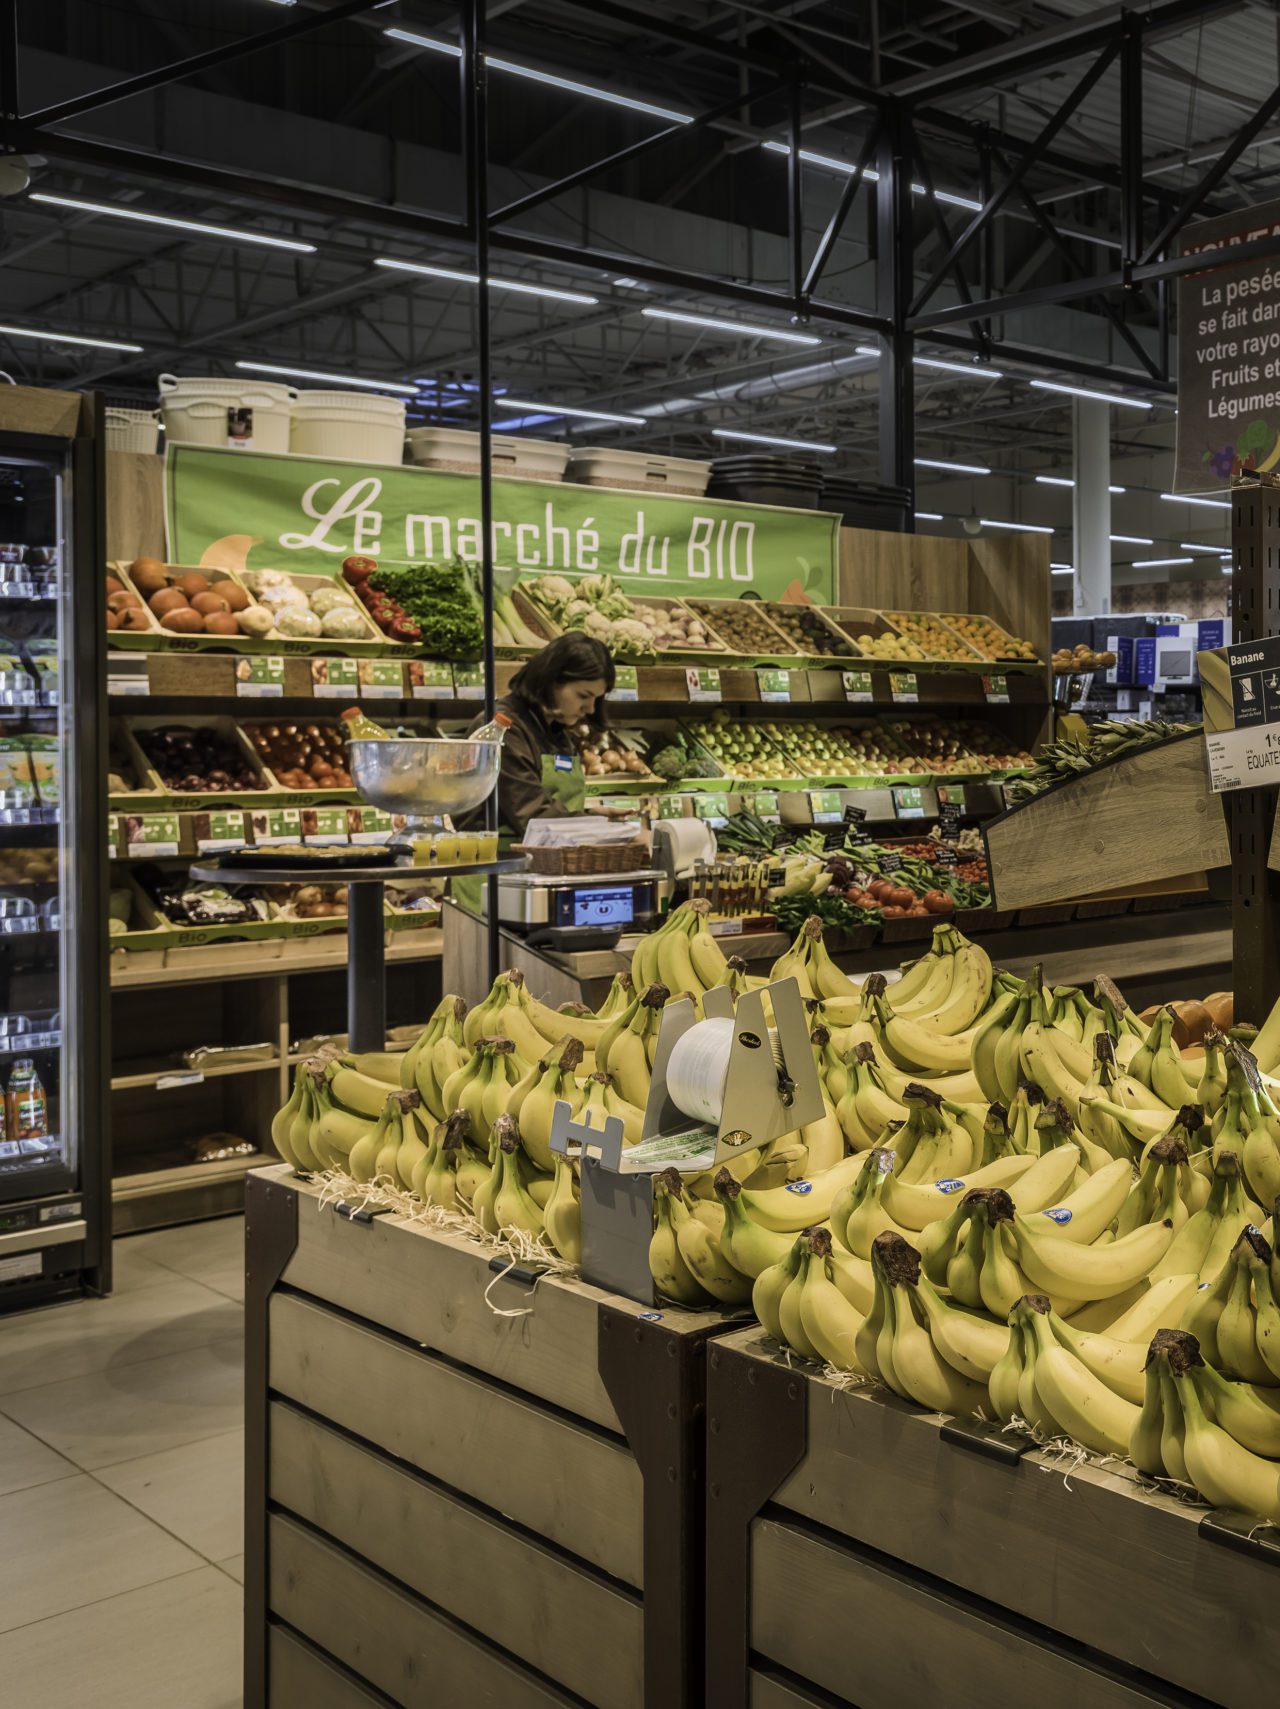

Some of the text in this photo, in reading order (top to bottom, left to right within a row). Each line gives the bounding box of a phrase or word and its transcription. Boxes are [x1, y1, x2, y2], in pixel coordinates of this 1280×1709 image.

[1202, 287, 1222, 306] La
[1198, 317, 1217, 335] se
[1221, 303, 1248, 330] fait
[1196, 339, 1238, 364] votre
[1211, 358, 1280, 389] Fruits et
[279, 477, 756, 582] Le marché du BIO
[169, 638, 198, 652] Bio
[284, 641, 311, 654] Bio
[390, 644, 417, 656] Bio
[1230, 651, 1265, 666] Banane
[737, 781, 756, 792] Bio
[808, 777, 826, 788] Bio
[873, 776, 890, 786] Bio
[171, 796, 201, 809] Bio
[287, 793, 313, 806] Bio
[292, 923, 319, 935] Bio
[178, 931, 207, 943] Bio
